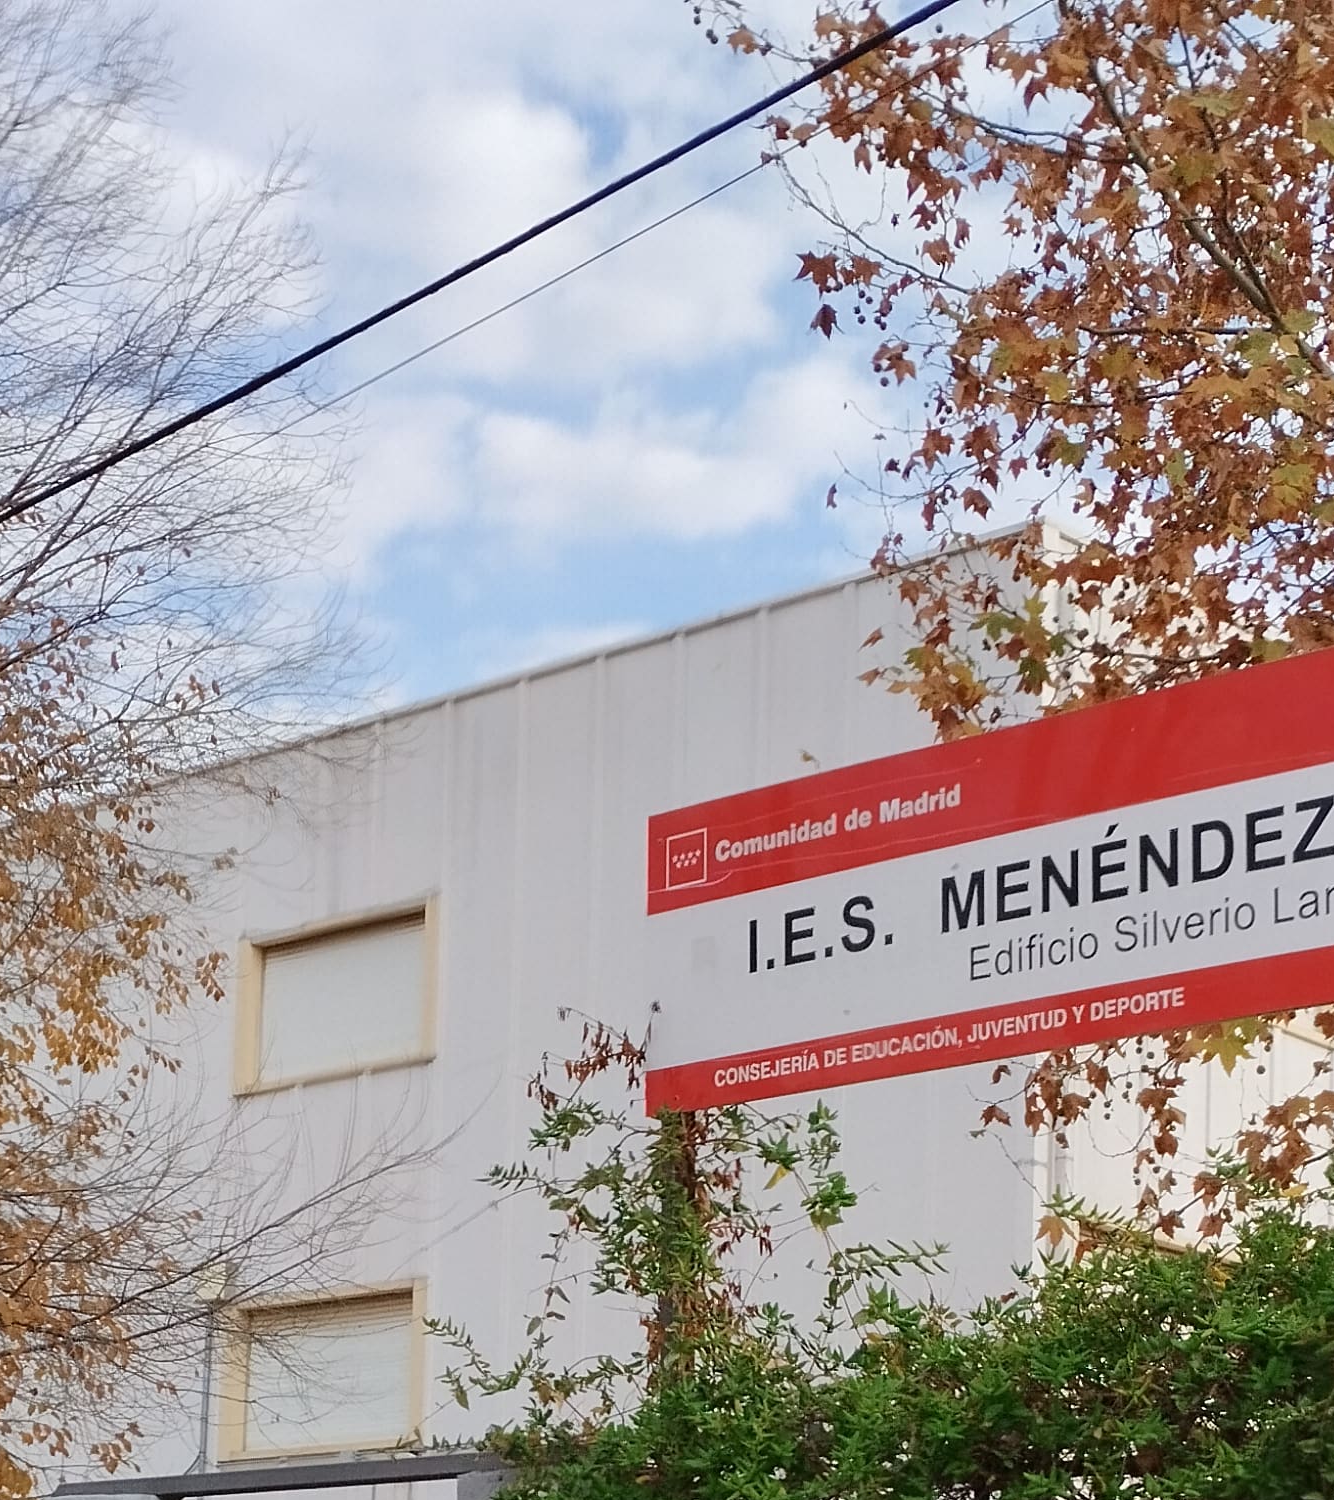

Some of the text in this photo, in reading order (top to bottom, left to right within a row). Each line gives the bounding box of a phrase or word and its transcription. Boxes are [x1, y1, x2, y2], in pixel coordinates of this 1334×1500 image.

[713, 783, 961, 863] Comunidad de Madrid
[748, 895, 894, 974] I.E.S.
[969, 926, 1099, 981] Edificio
[1113, 896, 1256, 953] Silverio
[713, 986, 1185, 1088] CONSEJERÍA DE EDUCACIÓN, JUVENTUD Y DEPORTE
